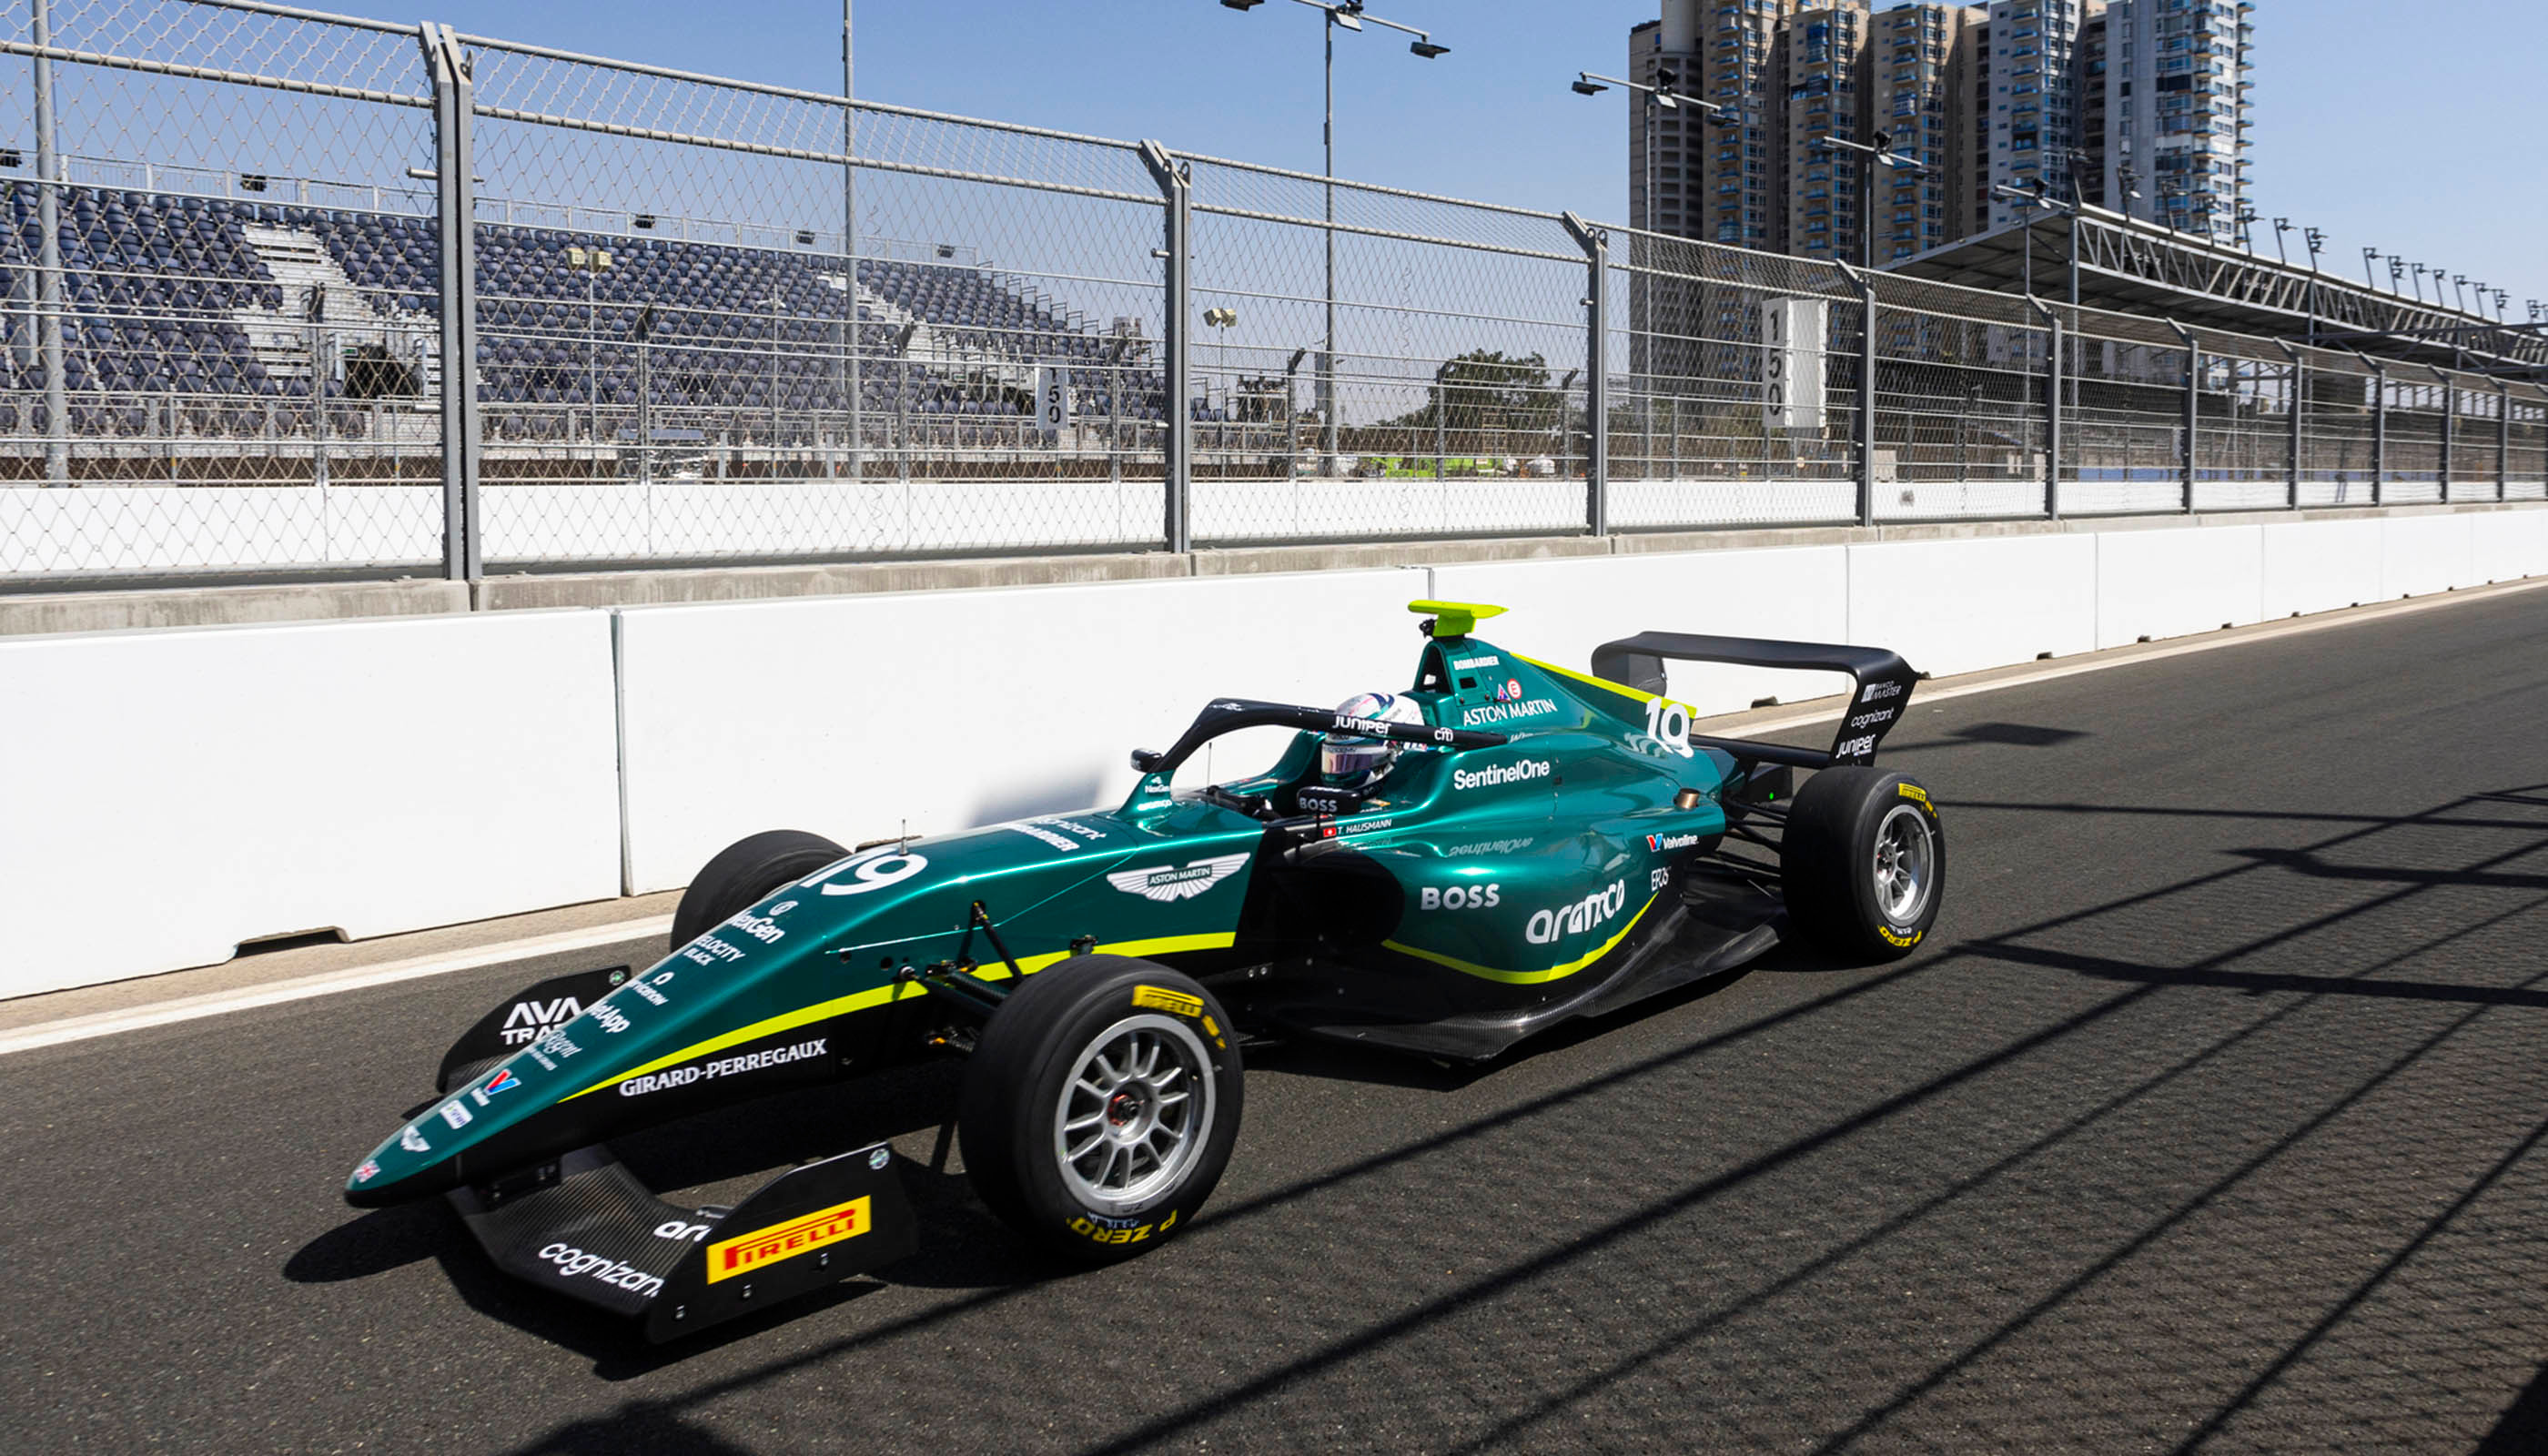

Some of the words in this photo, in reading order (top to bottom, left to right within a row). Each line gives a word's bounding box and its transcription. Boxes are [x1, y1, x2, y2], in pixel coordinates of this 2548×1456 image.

[1770, 309, 1783, 417] 150
[1464, 704, 1508, 726] ASTON
[1509, 699, 1558, 719] MARTIN
[1851, 706, 1895, 729] cognizant
[1453, 759, 1551, 791] SentinelOne
[1299, 797, 1338, 812] BOSS
[1338, 826, 1347, 834] T.
[1346, 819, 1392, 834] HAUSMANN
[800, 846, 928, 896] 19
[1149, 873, 1178, 885] ASTON
[1178, 867, 1211, 880] MARTIN
[1421, 883, 1501, 910] BOSS
[1525, 878, 1625, 945] aramco
[502, 996, 583, 1029] AVA
[1131, 985, 1205, 1018] PIRELLI
[619, 1038, 827, 1097] GIRARD-PERREGAUX
[1158, 1209, 1178, 1233] P
[724, 1208, 856, 1272] PIRELLI
[538, 1242, 665, 1299] cognizan
